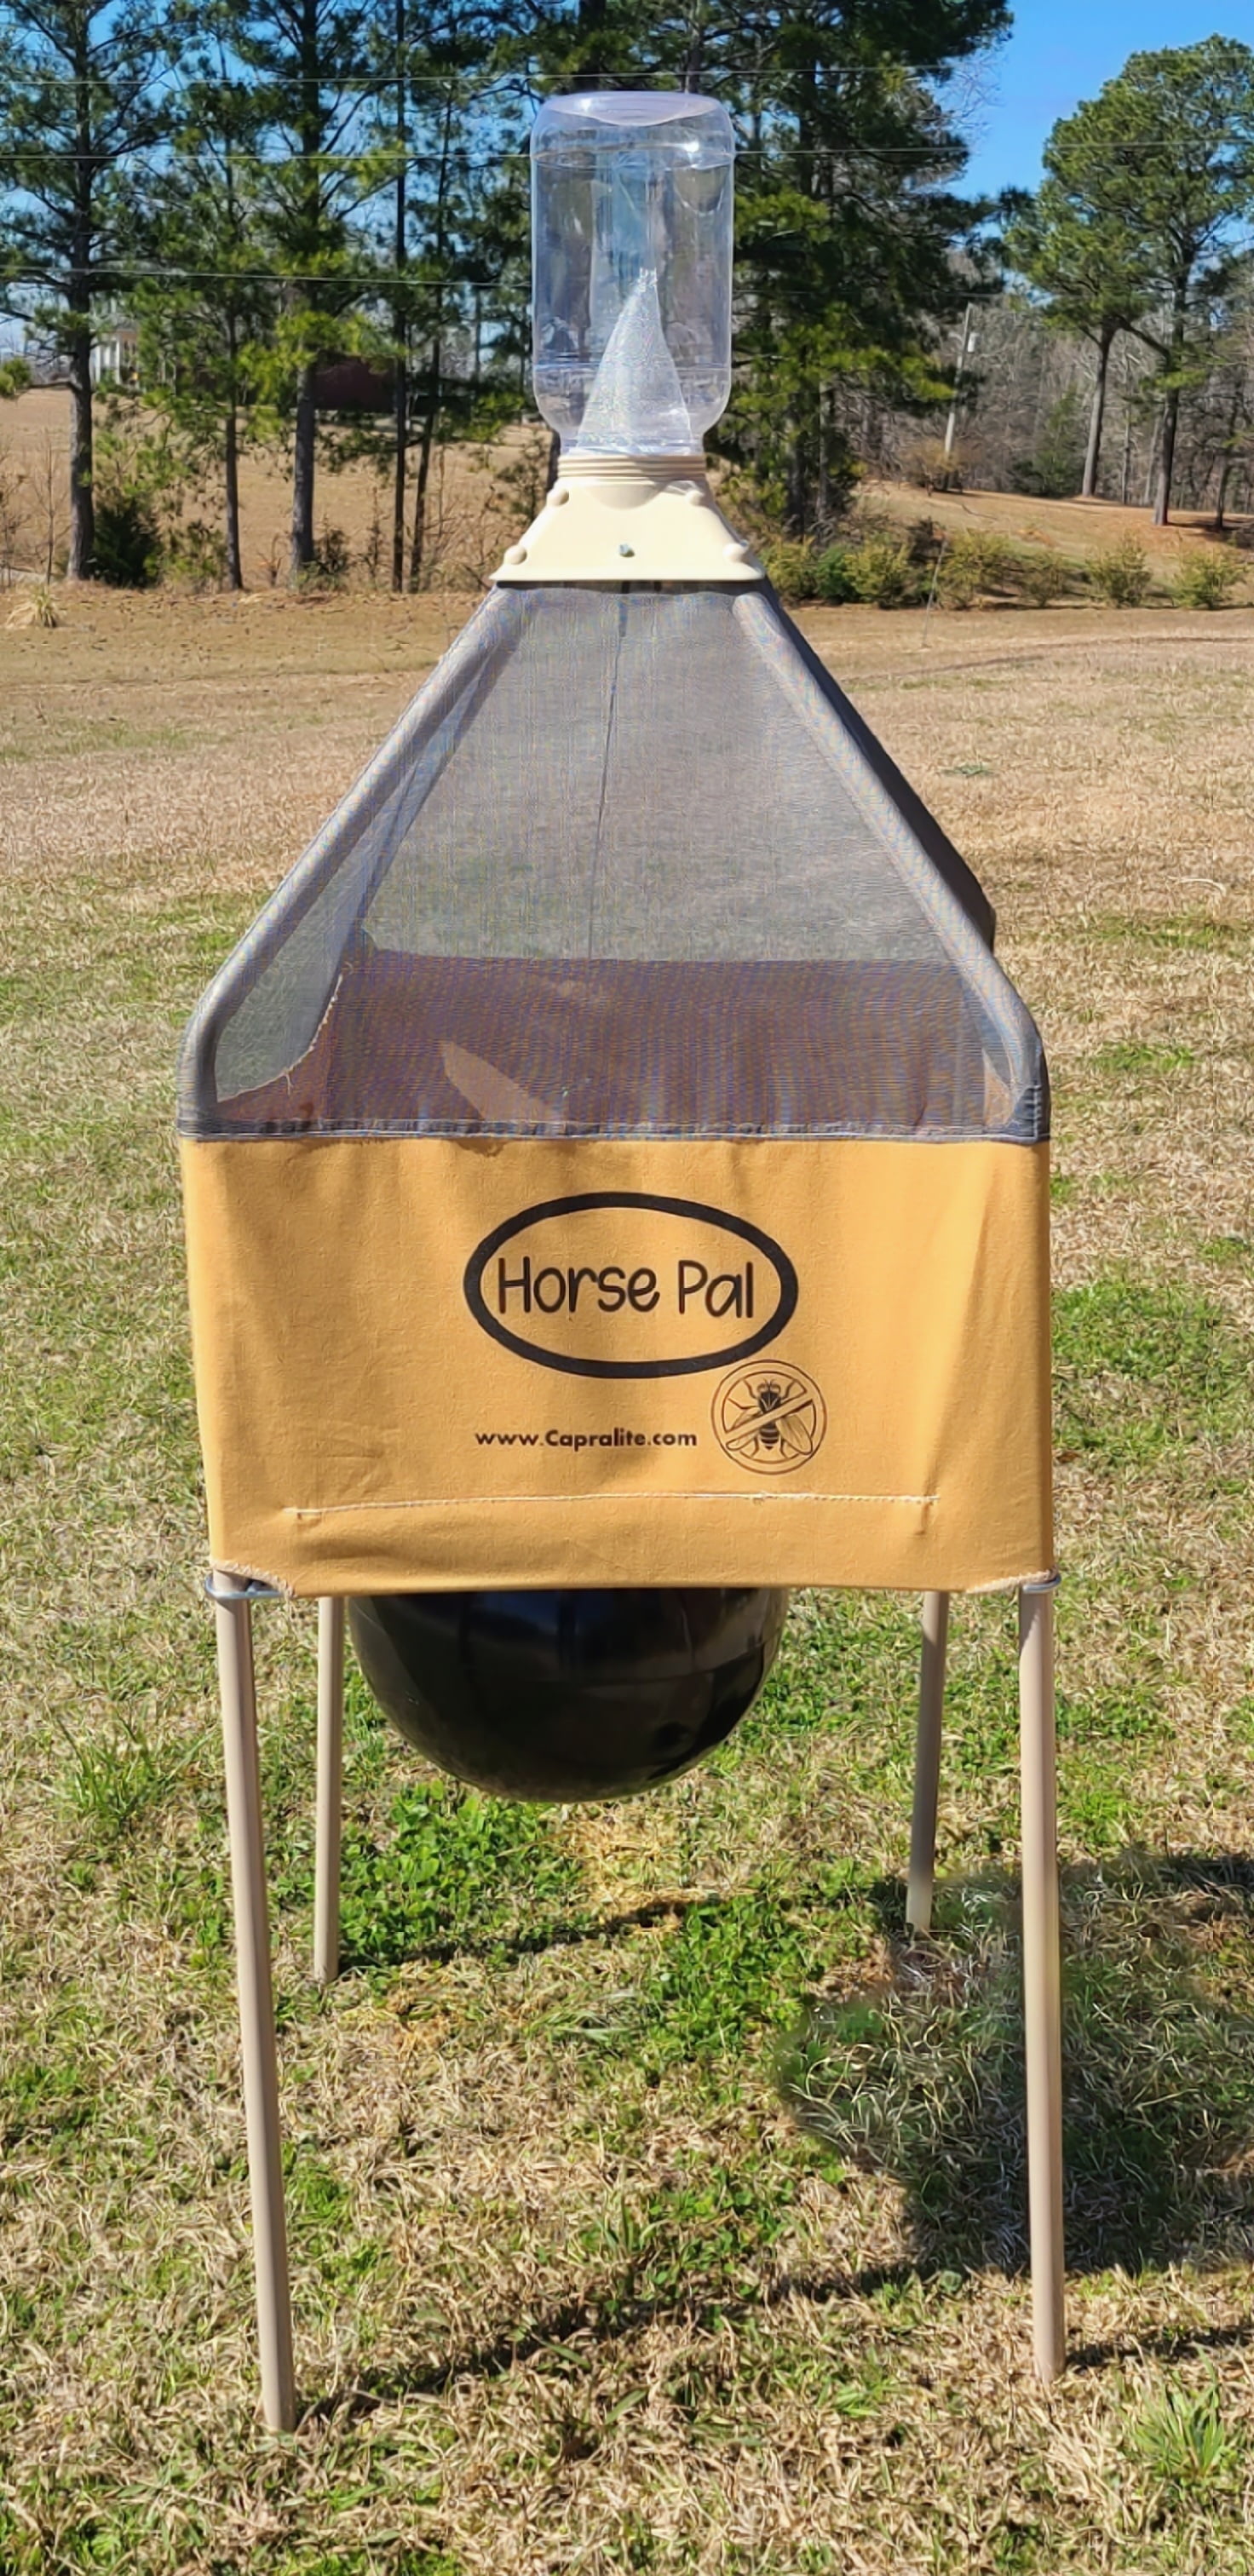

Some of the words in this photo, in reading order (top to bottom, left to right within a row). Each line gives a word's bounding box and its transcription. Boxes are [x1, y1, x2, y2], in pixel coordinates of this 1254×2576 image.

[498, 1256, 660, 1314] Horse
[678, 1259, 755, 1320] Pal
[475, 1427, 698, 1452] www.Capralite.com
